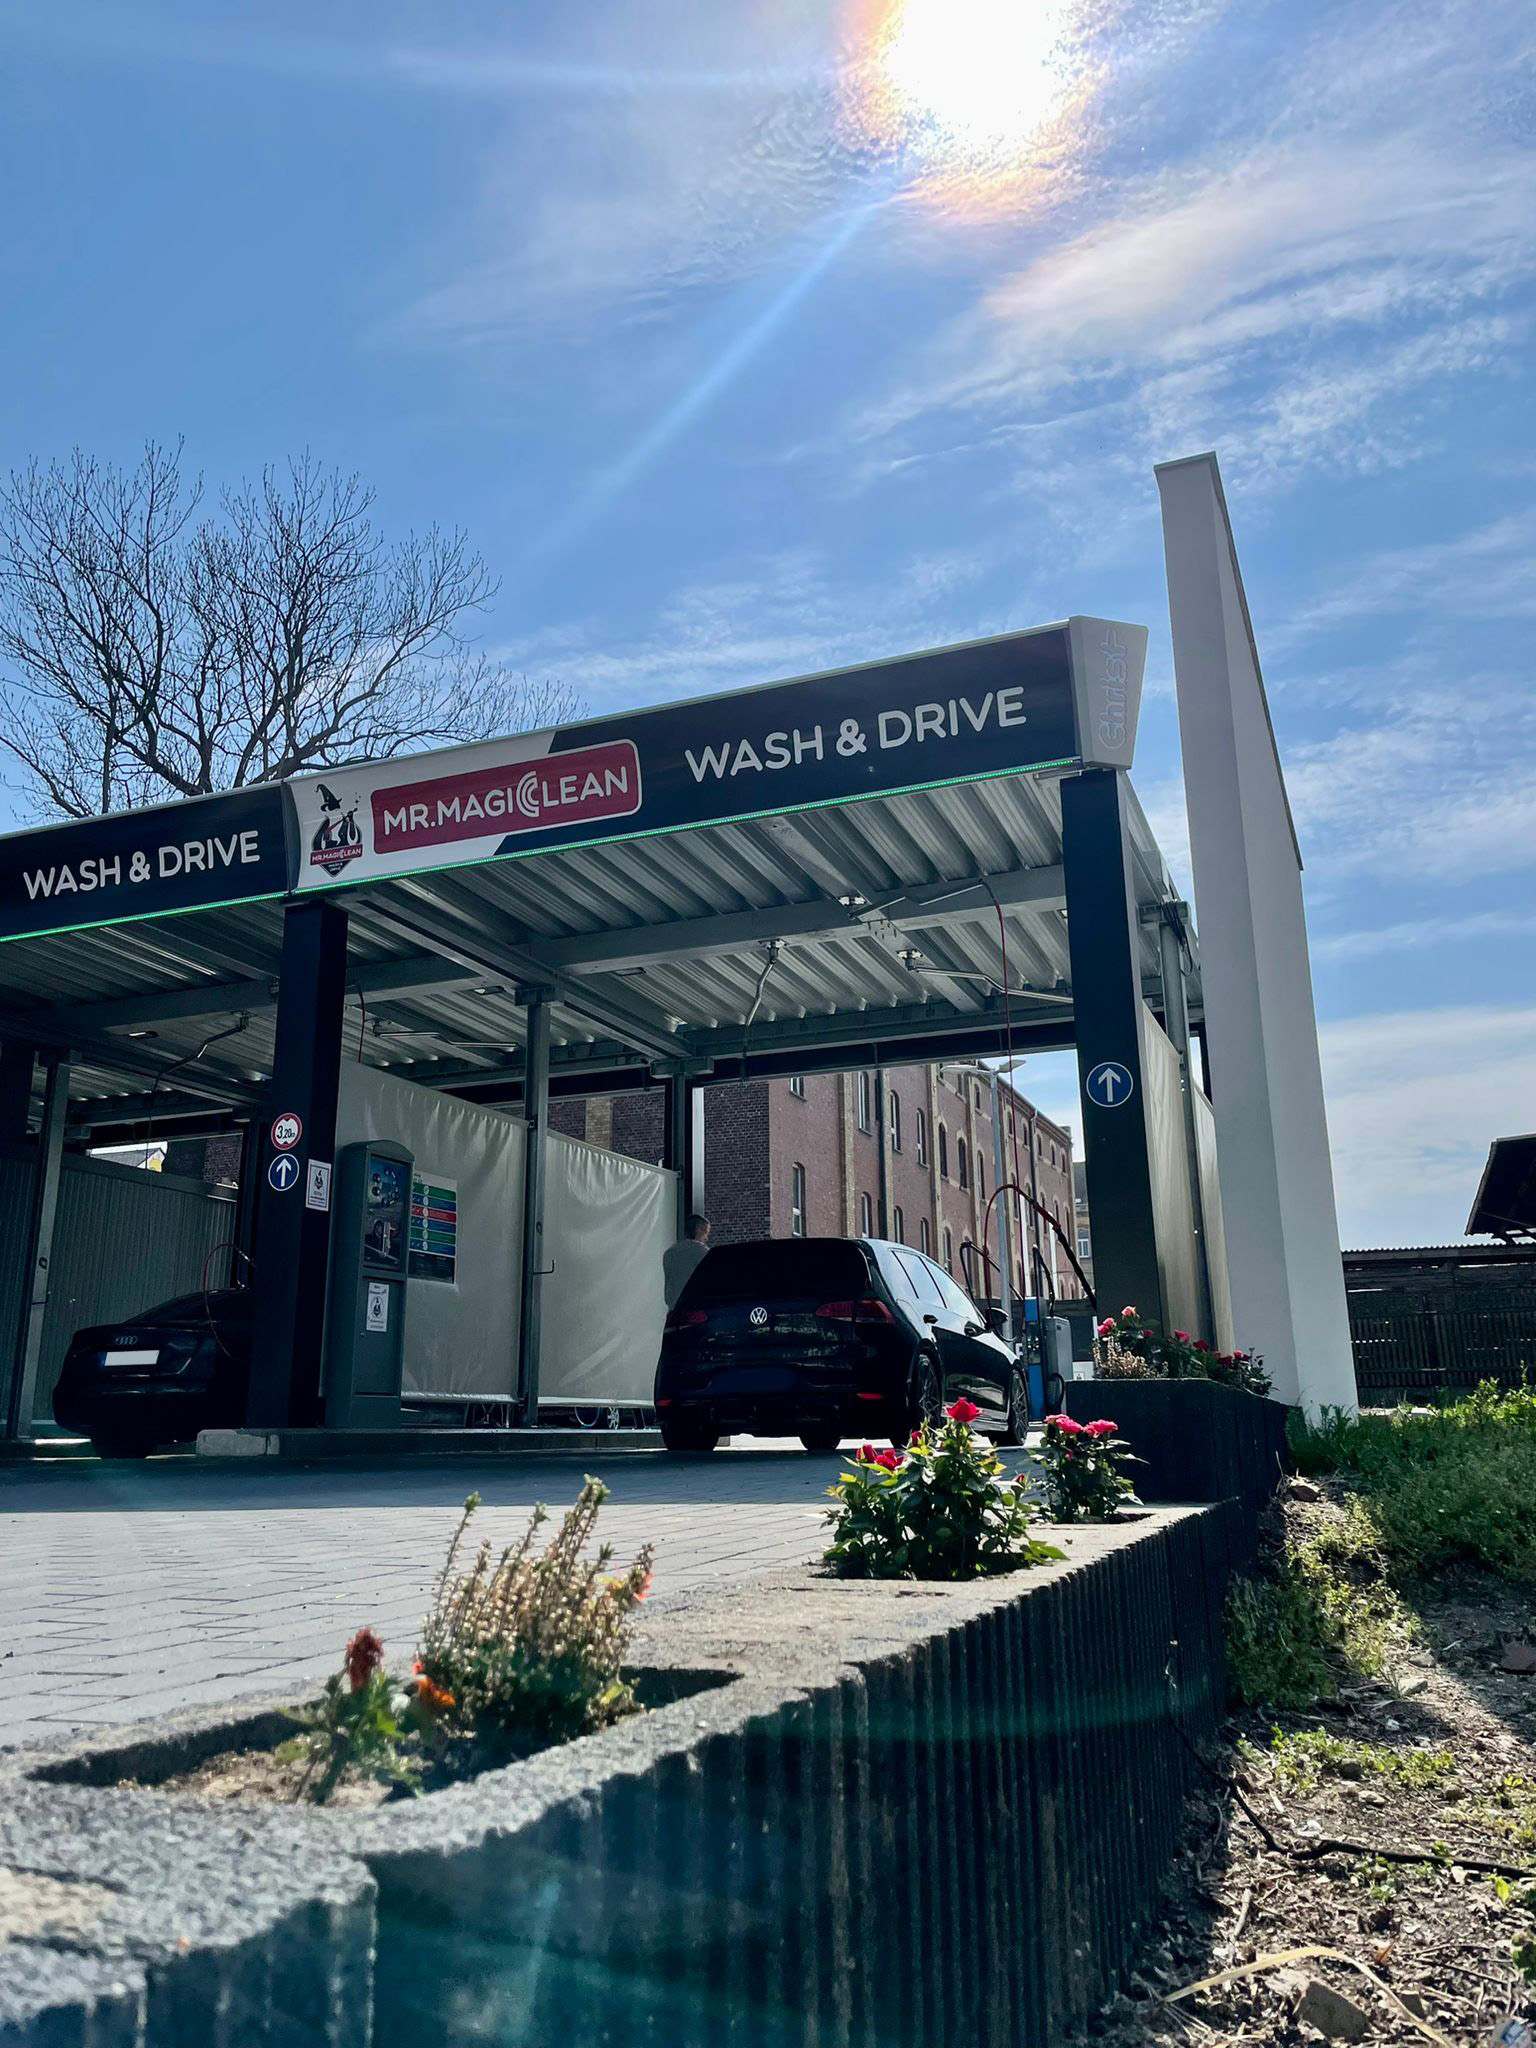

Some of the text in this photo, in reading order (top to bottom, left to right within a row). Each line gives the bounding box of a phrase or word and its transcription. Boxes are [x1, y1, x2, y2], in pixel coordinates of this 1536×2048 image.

[685, 686, 1027, 783] WASH & DRIVE
[23, 830, 261, 900] WASH & DRIVE
